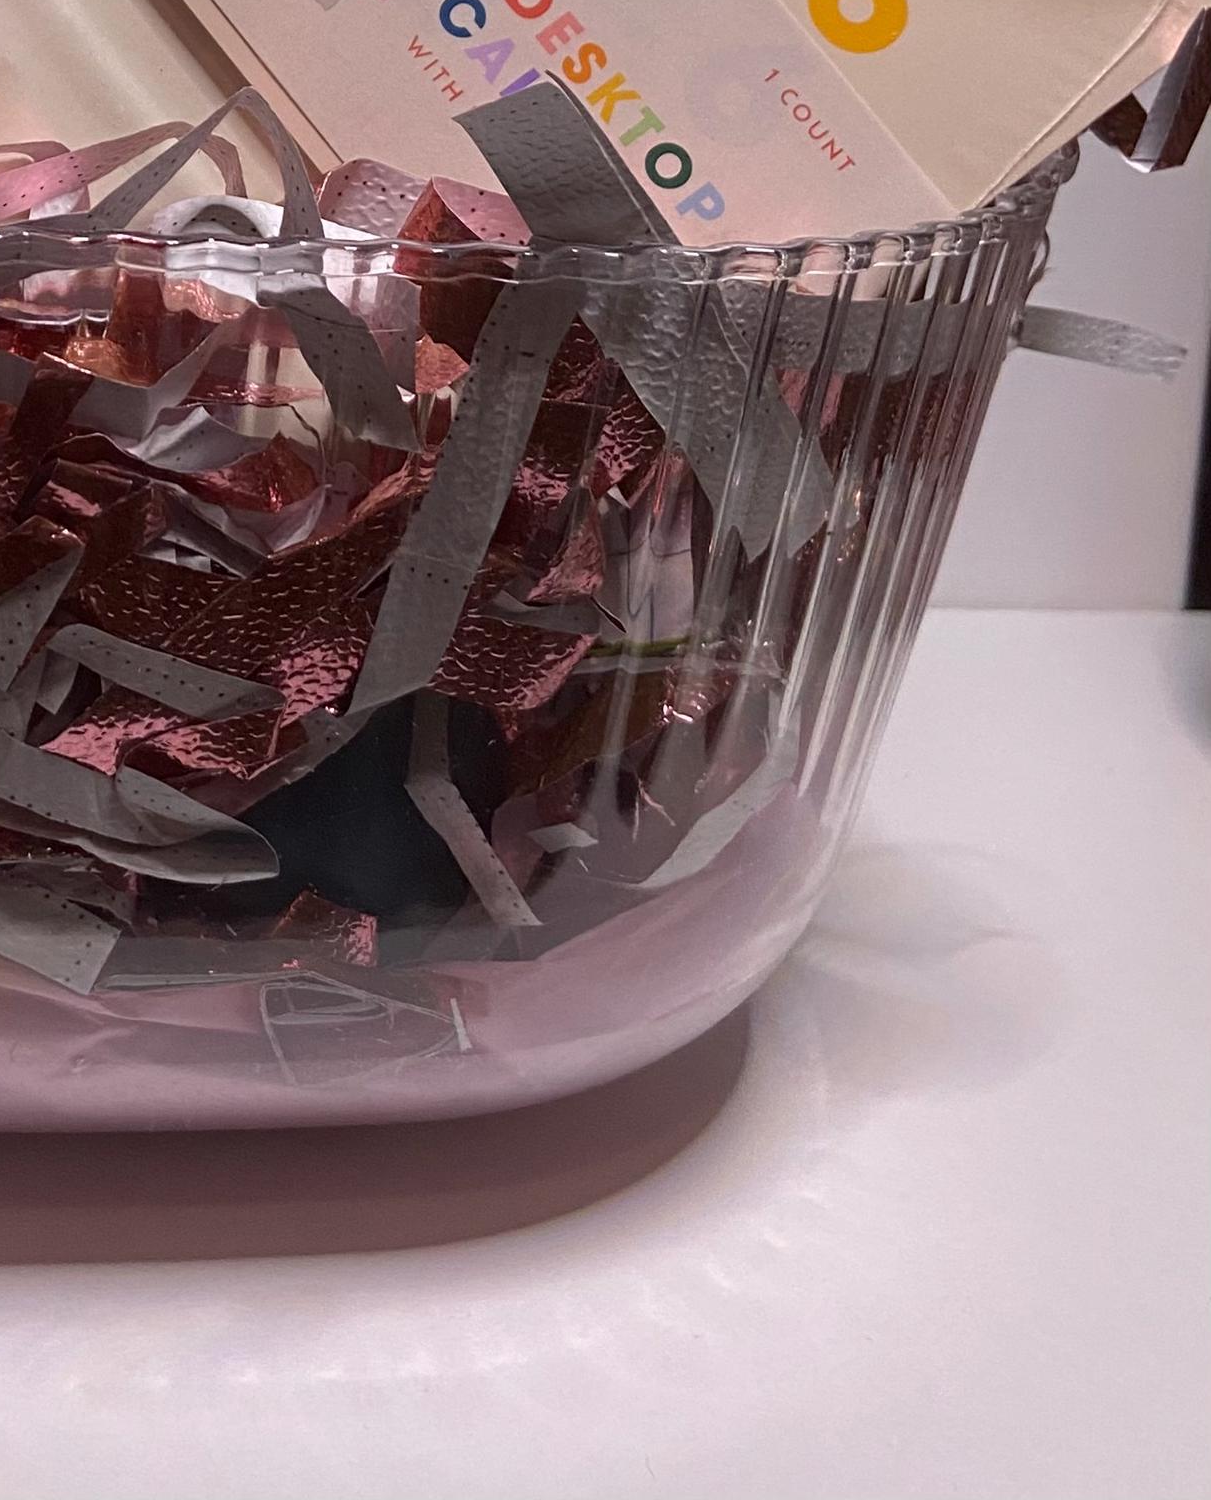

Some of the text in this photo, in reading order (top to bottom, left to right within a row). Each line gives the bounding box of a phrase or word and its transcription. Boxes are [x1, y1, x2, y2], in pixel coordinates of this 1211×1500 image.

[407, 35, 464, 102] WITH
[764, 68, 856, 171] 1 COUNT
